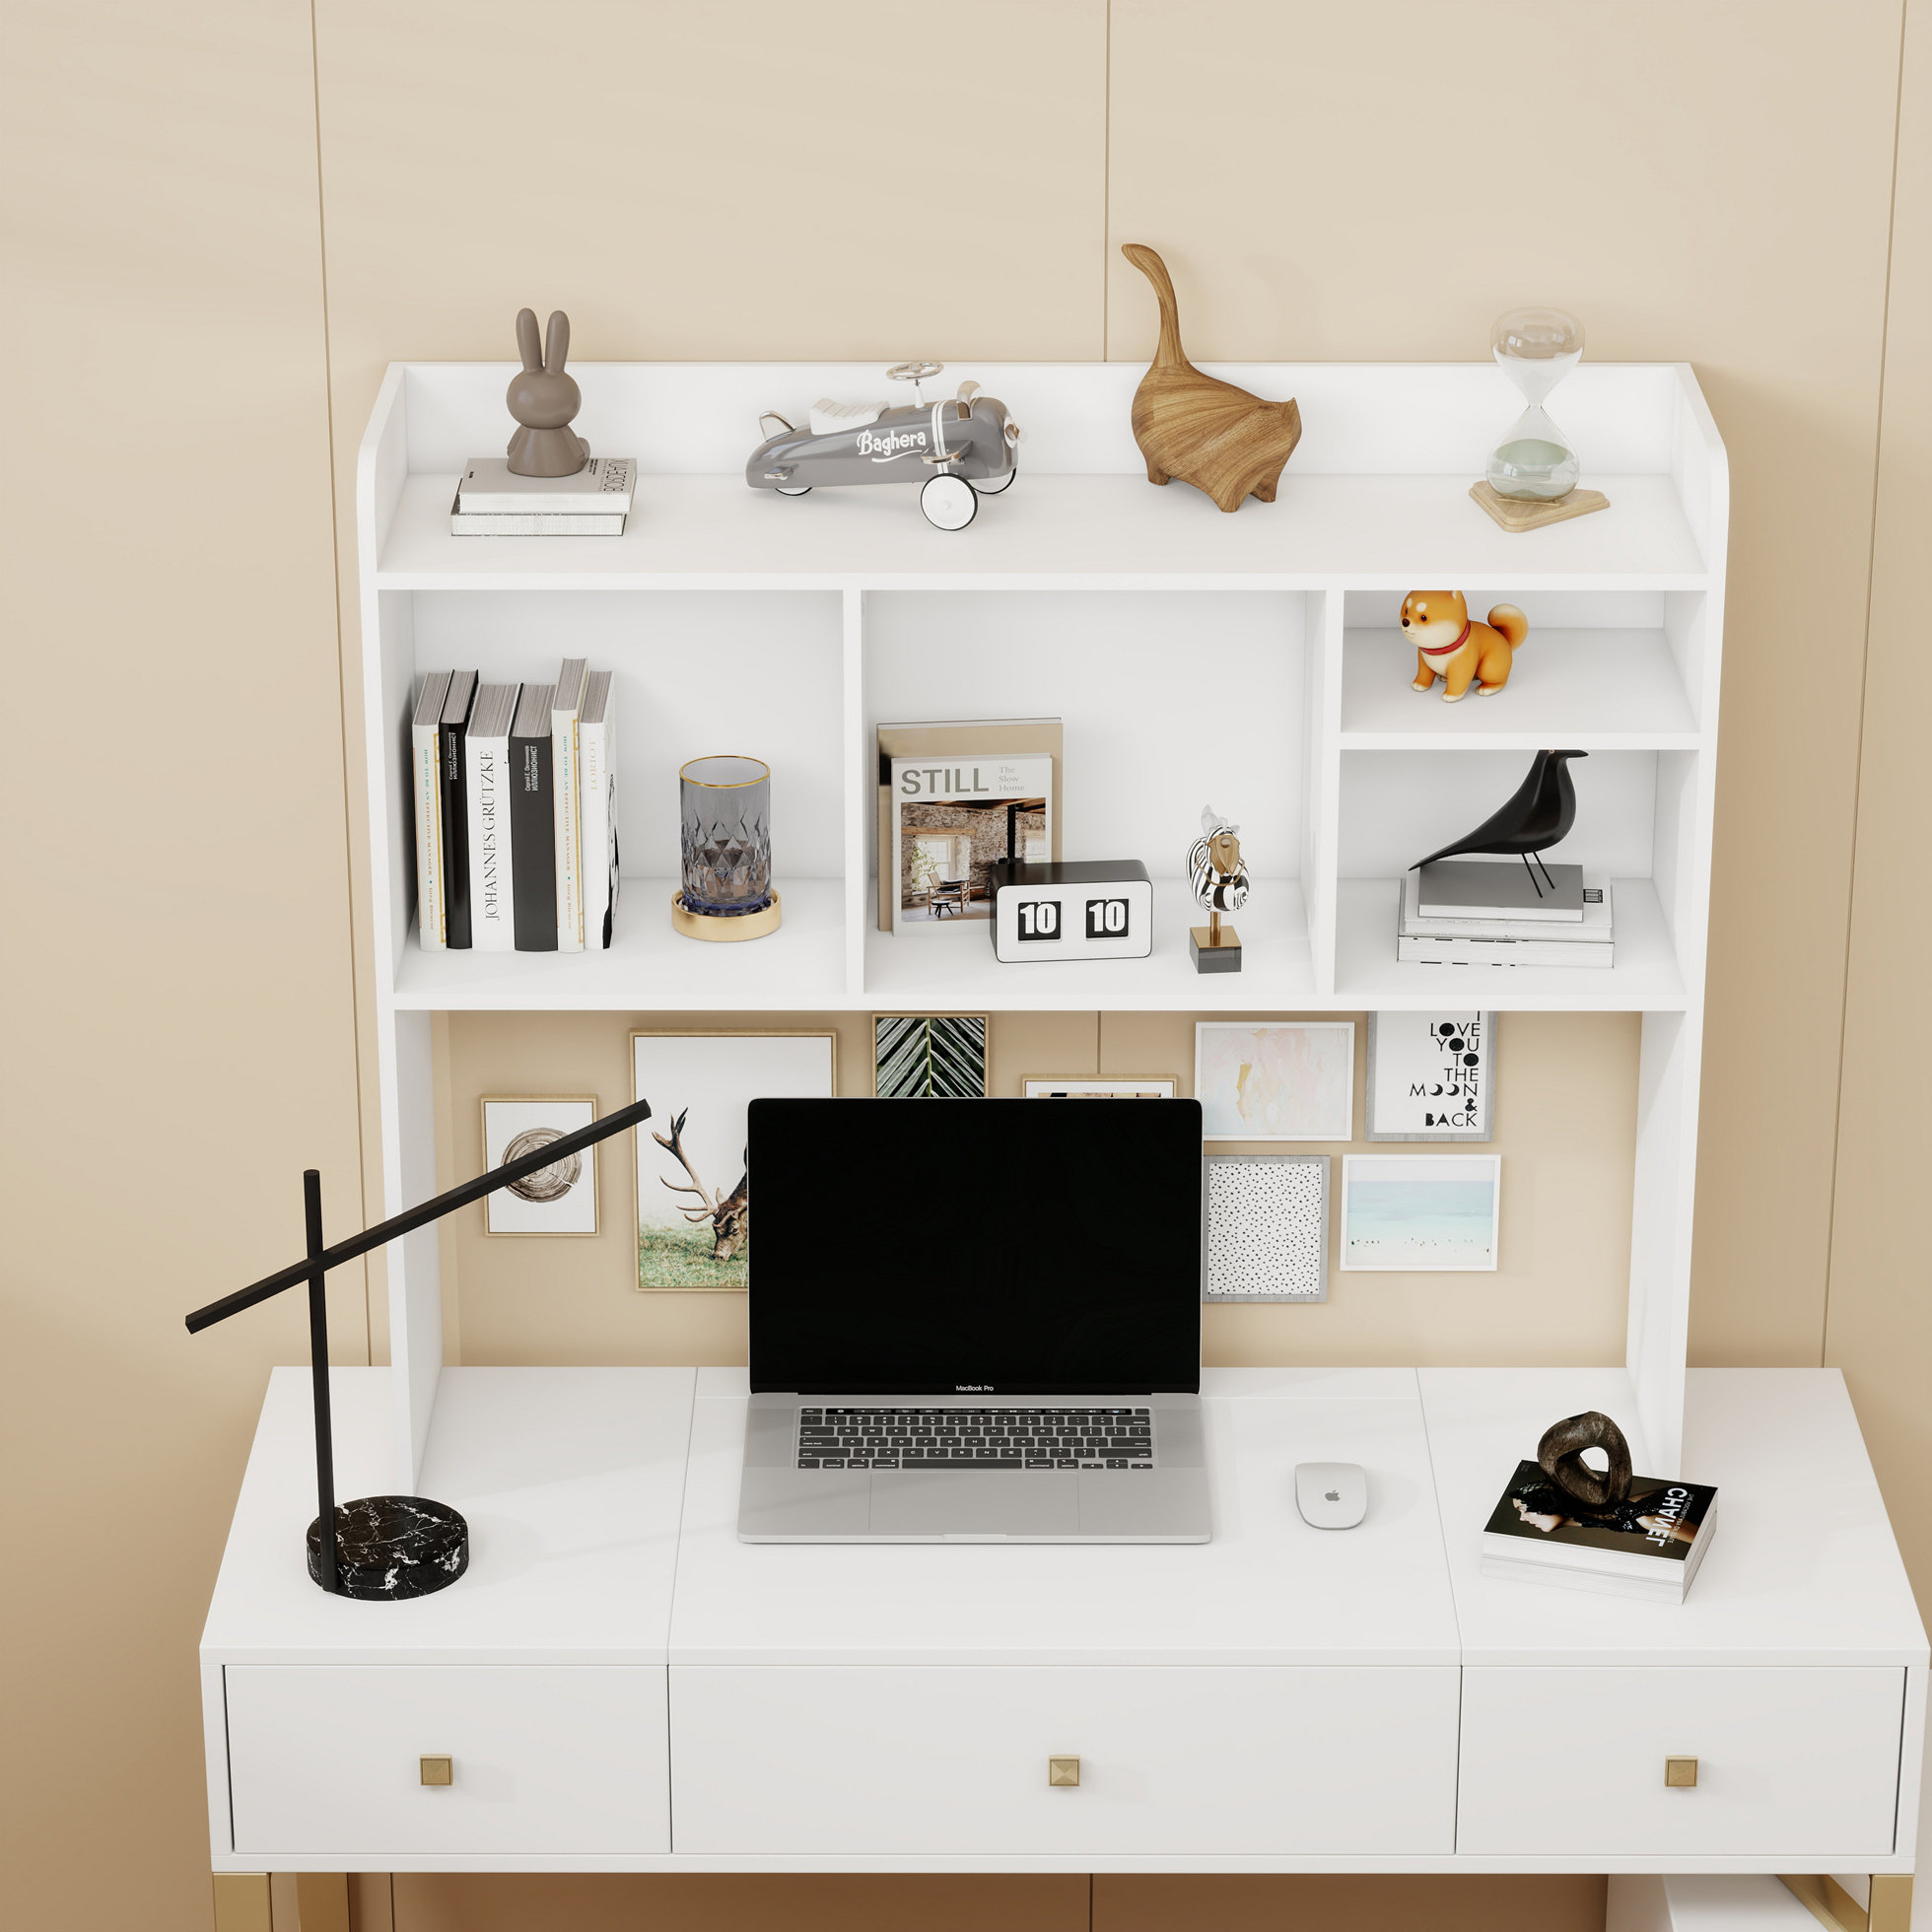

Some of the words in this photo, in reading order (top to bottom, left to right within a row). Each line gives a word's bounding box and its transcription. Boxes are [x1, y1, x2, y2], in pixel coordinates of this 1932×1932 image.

[856, 429, 927, 457] Baghera
[999, 765, 1015, 775] The
[900, 767, 990, 795] STILL
[998, 775, 1019, 784] Slow
[479, 750, 496, 831] GRÜTZKE
[999, 784, 1025, 793] Home
[483, 833, 500, 922] JOHANNES
[1019, 903, 1057, 934] 10
[1088, 901, 1126, 932] 10
[1430, 1022, 1481, 1037] LOVE
[1436, 1038, 1480, 1052] YOU
[1453, 1053, 1480, 1067] TO
[1444, 1068, 1479, 1082] THE
[1410, 1082, 1478, 1097] MOON
[1465, 1097, 1478, 1112] &
[1425, 1112, 1478, 1127] BACK
